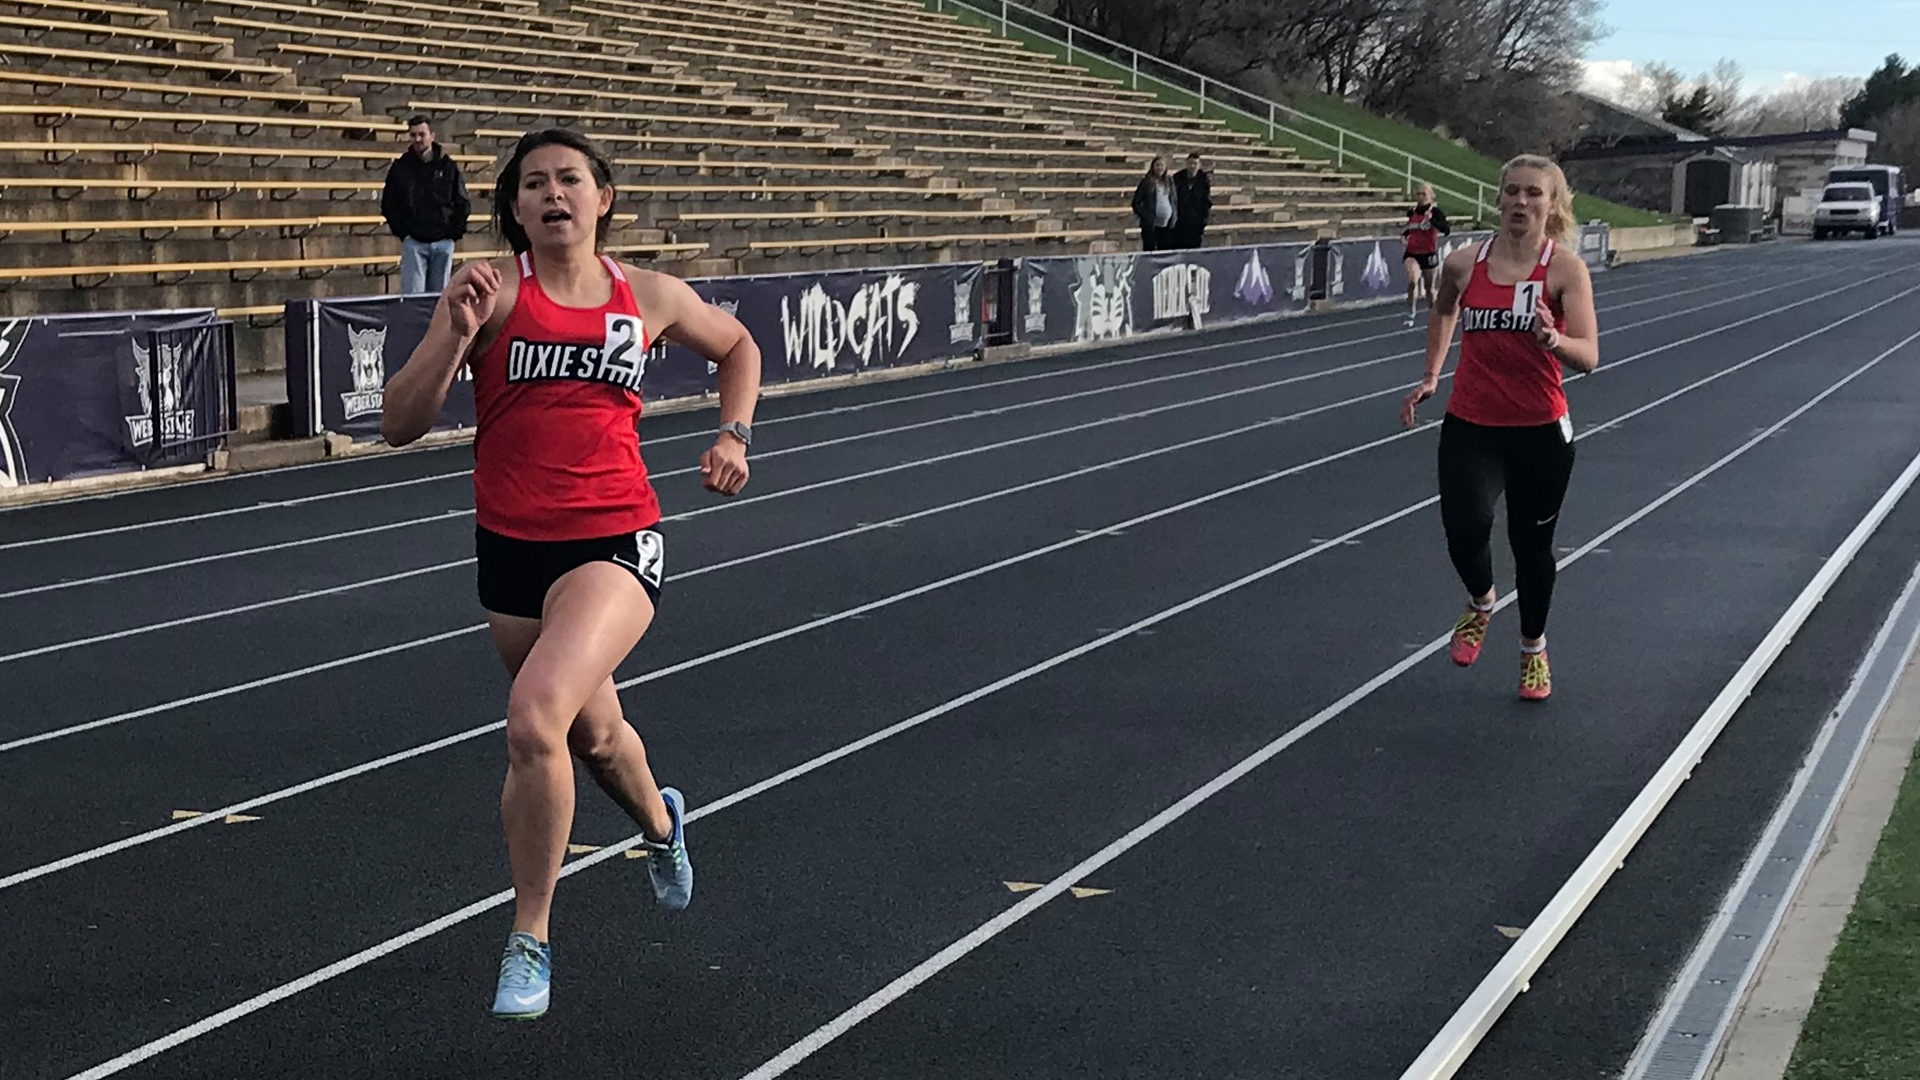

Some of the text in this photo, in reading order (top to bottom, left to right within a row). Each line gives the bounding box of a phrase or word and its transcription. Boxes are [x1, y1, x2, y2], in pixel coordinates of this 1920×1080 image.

[1522, 283, 1534, 314] 1
[780, 272, 920, 372] WILDCATS
[1463, 307, 1535, 331] DIXIE STA
[509, 341, 576, 381] DIXIE
[607, 319, 635, 369] 2
[132, 417, 164, 440] WEB
[642, 532, 660, 582] 2
